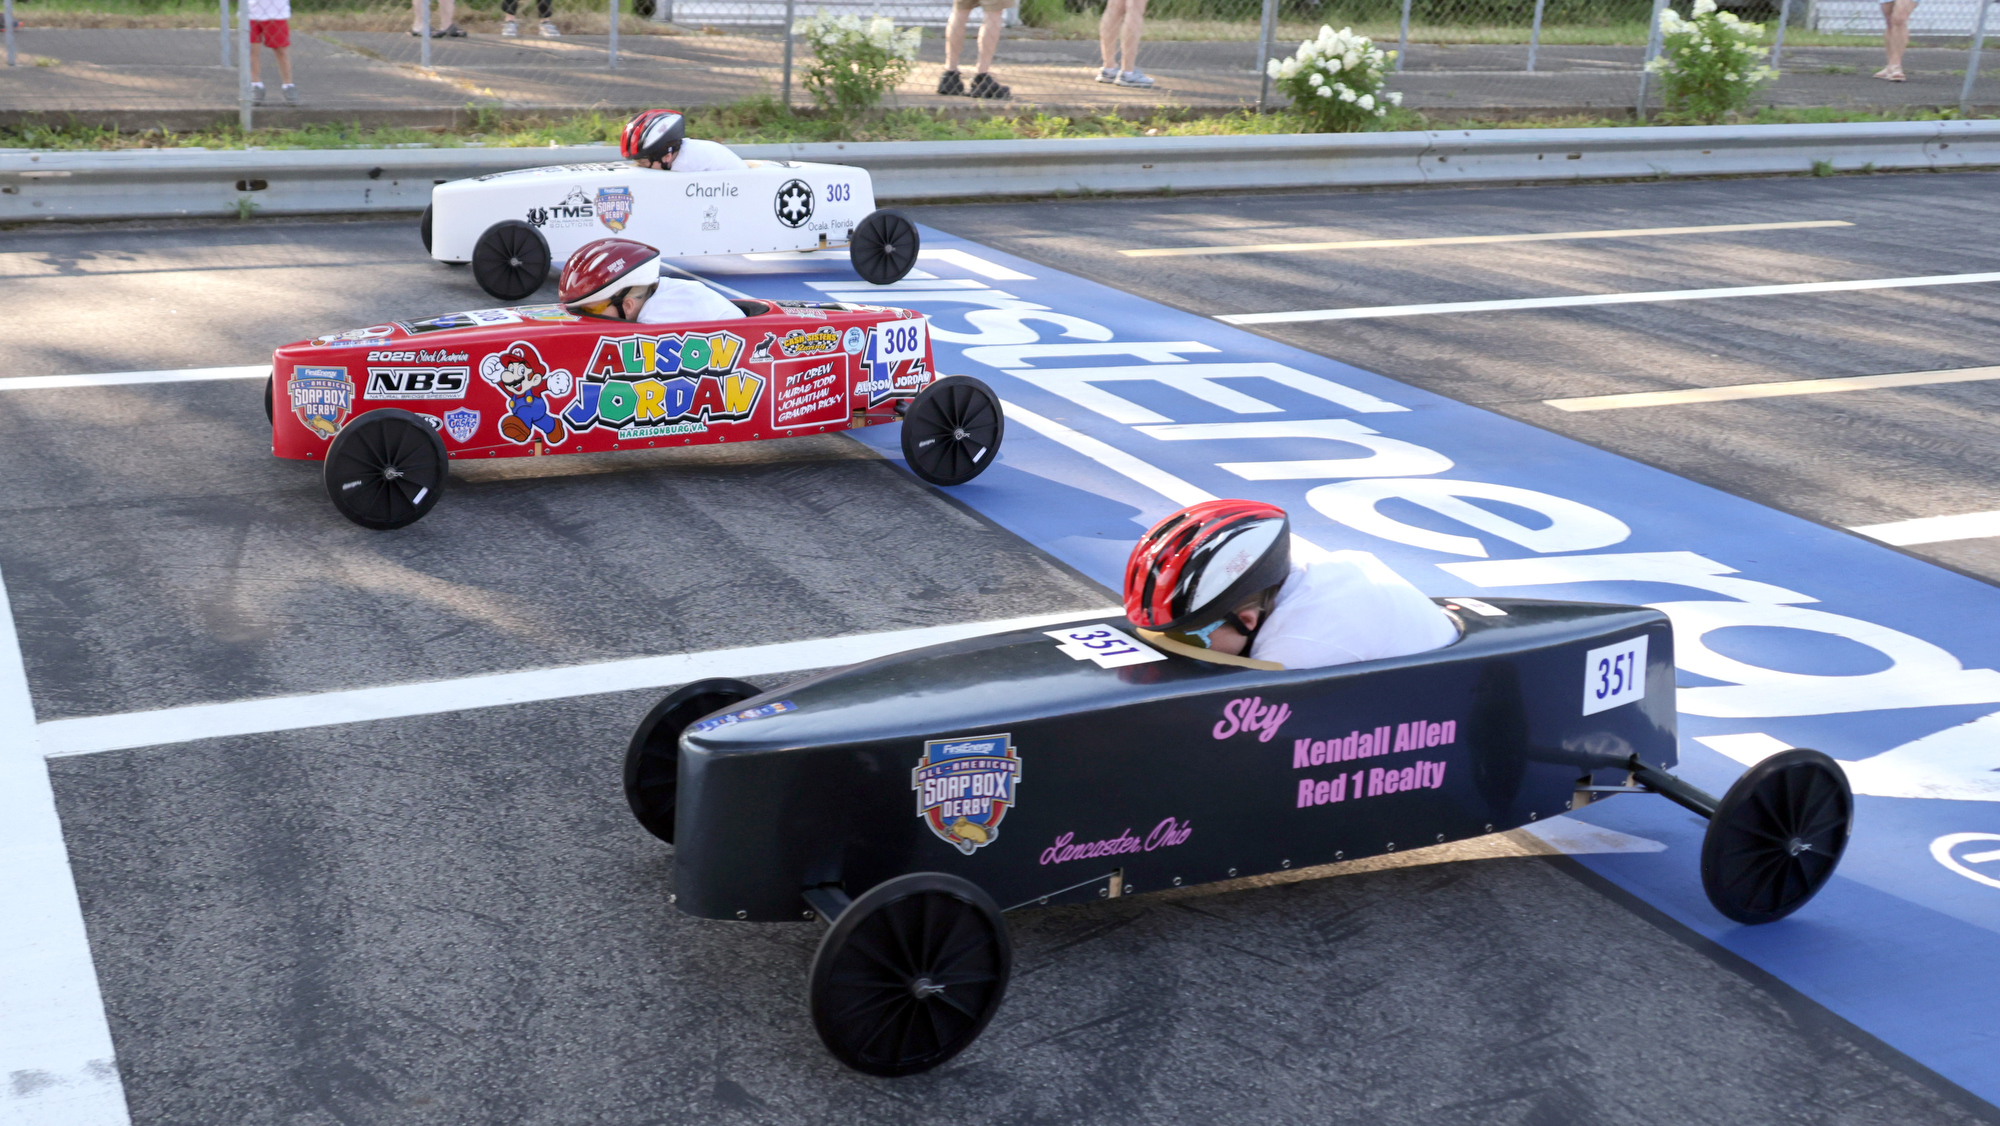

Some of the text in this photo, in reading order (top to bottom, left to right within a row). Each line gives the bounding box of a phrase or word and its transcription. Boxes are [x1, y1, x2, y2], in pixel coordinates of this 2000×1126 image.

[685, 182, 739, 197] Charlie
[826, 183, 851, 202] 303
[549, 206, 593, 218] TMS
[597, 200, 630, 213] SOAP BOX
[604, 210, 623, 218] DERBY
[831, 219, 854, 229] Florida
[784, 335, 805, 347] CASH
[807, 333, 837, 342] SISTERS
[796, 343, 826, 351] Racing
[885, 326, 918, 354] 308
[367, 351, 416, 361] 2025
[437, 349, 469, 362] Champion
[588, 335, 742, 379] ALISON
[305, 369, 337, 378] FirstEnergy
[370, 371, 466, 392] NBS
[786, 361, 834, 387] PIT CREW
[813, 374, 837, 389] TODD
[854, 371, 931, 395] ALISON JORDAN
[295, 389, 346, 407] SOAP BOX
[565, 372, 763, 426] JORDAN
[778, 392, 844, 422] GRANDPA RICKY
[307, 404, 336, 415] DERBY
[619, 424, 690, 439] HARRISONBURG
[1069, 631, 1140, 656] 351
[1596, 651, 1635, 700] 351
[1212, 696, 1292, 743] Sky
[943, 742, 995, 755] FirstEnergy
[1293, 720, 1457, 769] Kendall Allen
[924, 771, 1008, 806] SOAP BOX
[1297, 760, 1446, 808] Red 1 Realty
[943, 797, 991, 817] DERBY
[1144, 817, 1192, 851] Ohio
